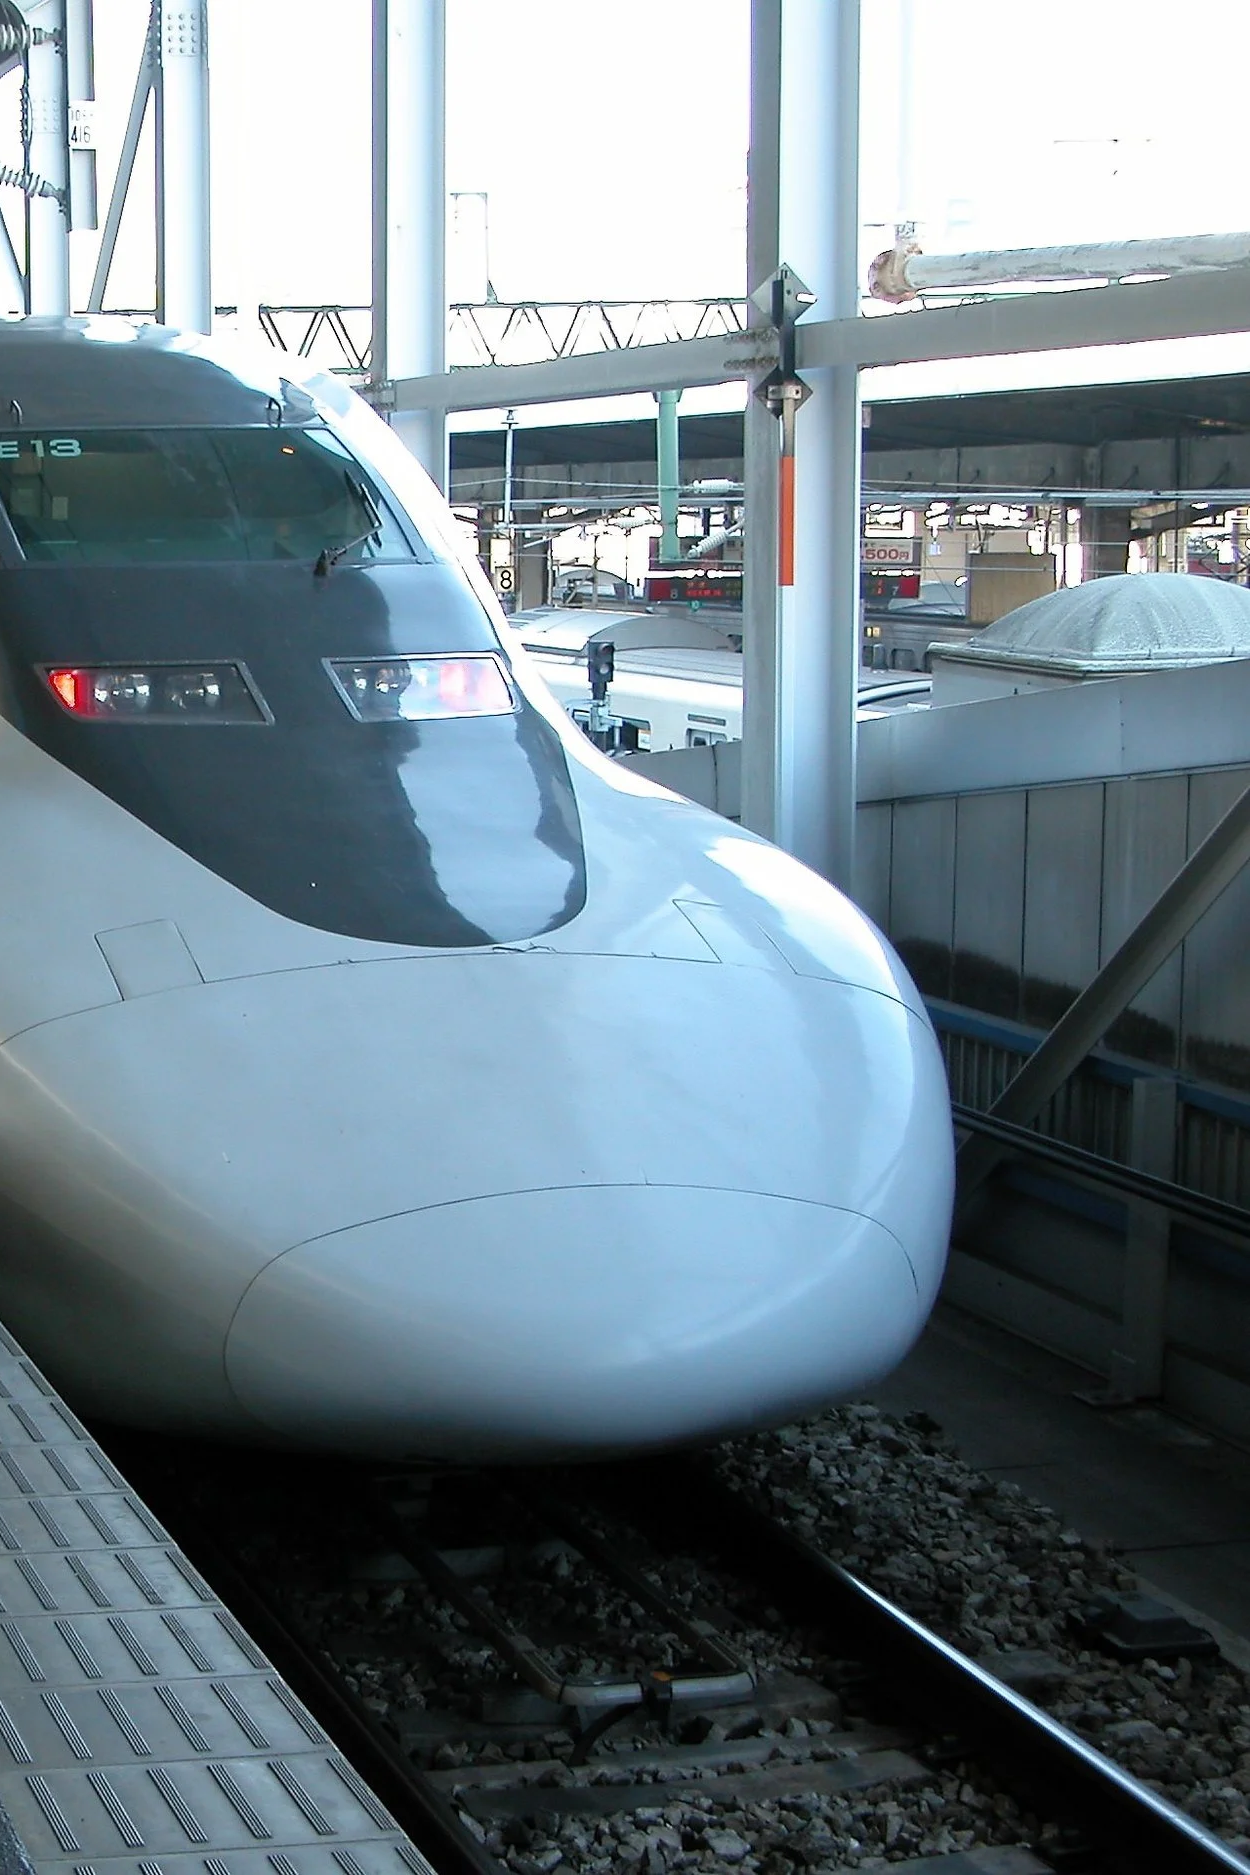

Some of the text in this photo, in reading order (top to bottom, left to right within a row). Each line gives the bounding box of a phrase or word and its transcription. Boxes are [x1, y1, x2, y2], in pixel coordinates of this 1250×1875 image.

[500, 570, 512, 589] 8
[670, 588, 678, 599] 8
[892, 586, 900, 596] 7
